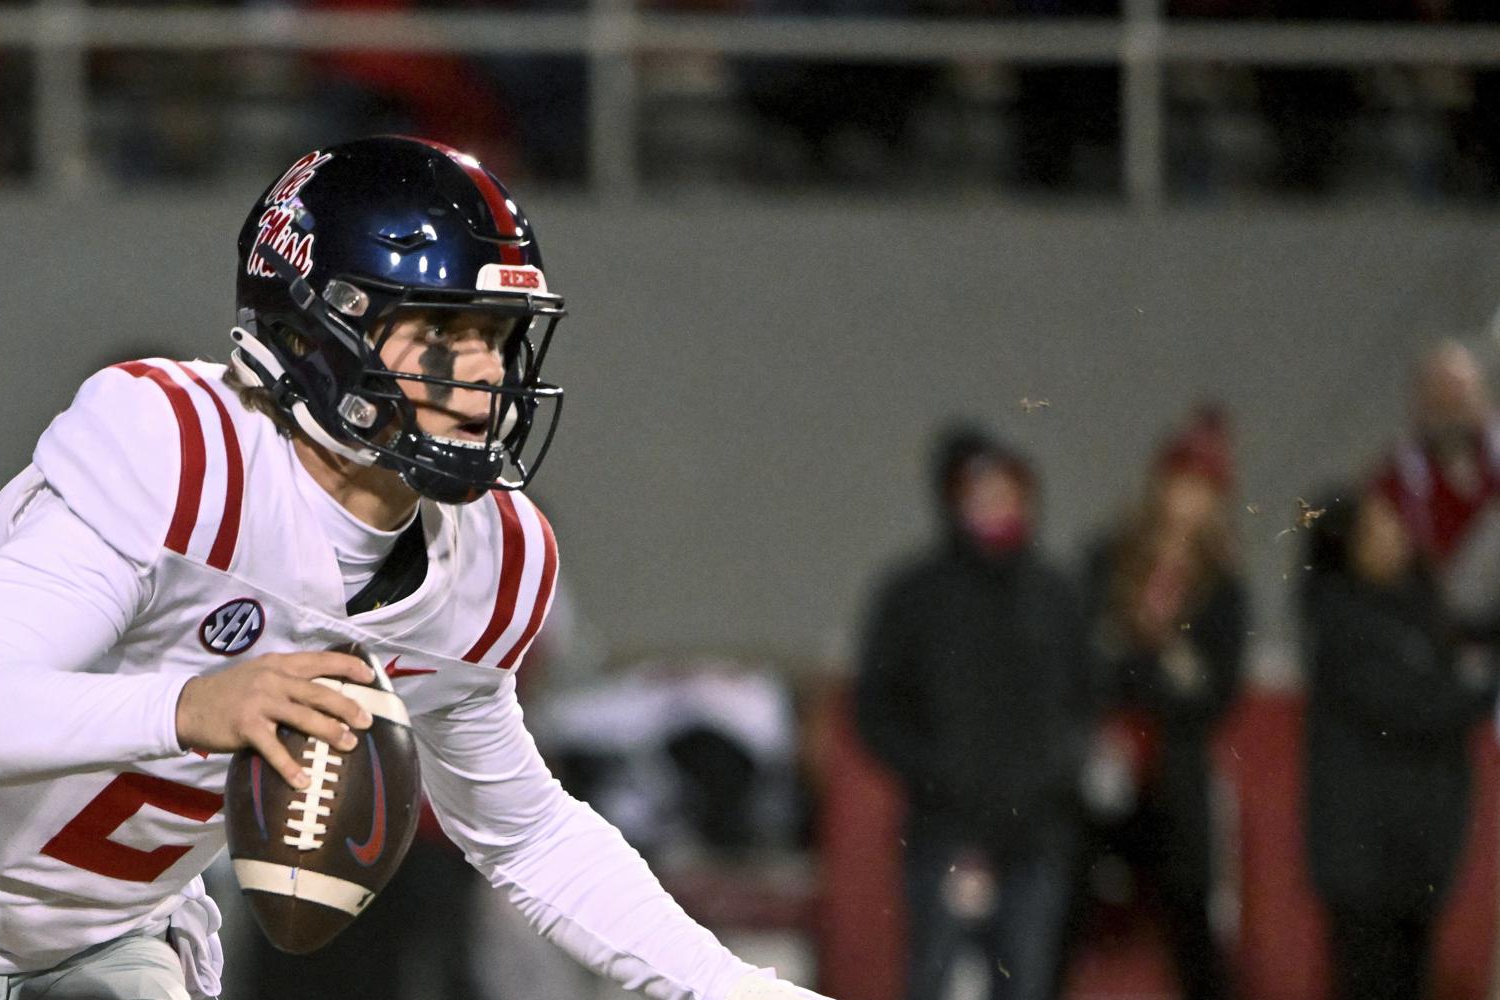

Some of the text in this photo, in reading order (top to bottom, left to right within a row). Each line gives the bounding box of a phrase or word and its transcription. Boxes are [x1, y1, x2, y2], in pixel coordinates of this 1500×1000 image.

[264, 150, 332, 206] Ole
[246, 205, 315, 279] Miss
[499, 269, 540, 289] REBS
[203, 601, 261, 653] SEC
